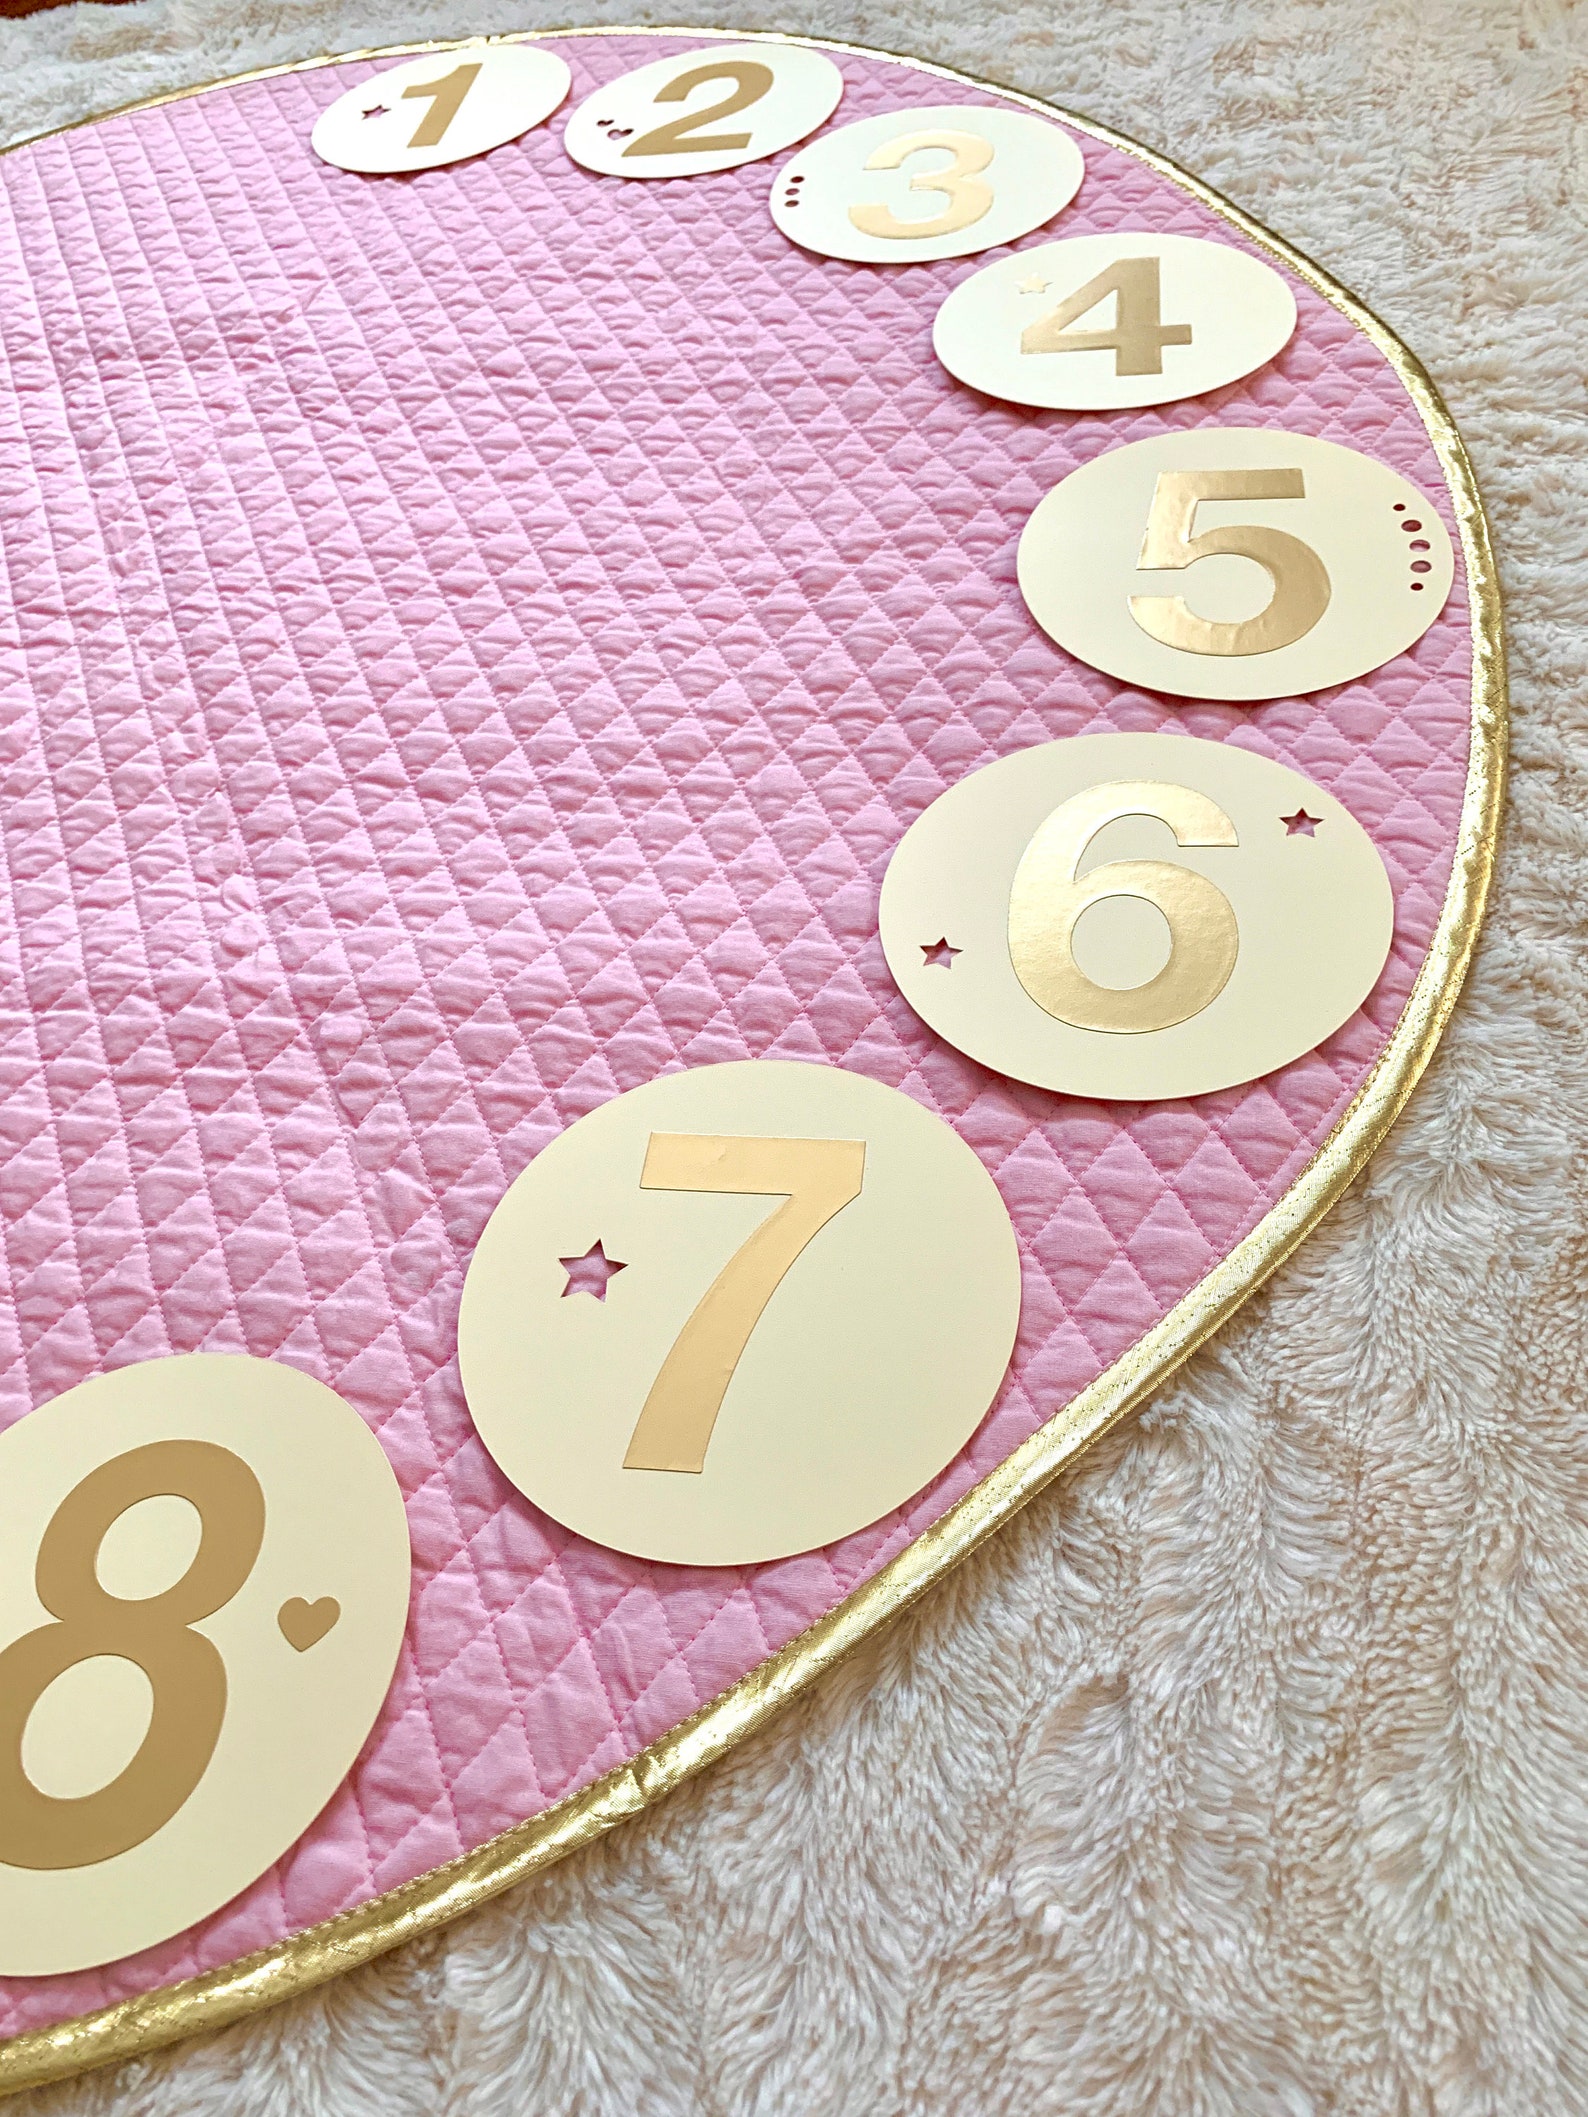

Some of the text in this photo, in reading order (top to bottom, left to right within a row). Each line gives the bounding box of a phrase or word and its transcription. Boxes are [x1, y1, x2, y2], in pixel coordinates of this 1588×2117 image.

[401, 63, 484, 149] 1
[622, 61, 775, 158] 2
[847, 128, 994, 240] 3
[1020, 256, 1193, 377] 4
[1127, 467, 1332, 657] 5
[1007, 779, 1240, 1035] 6
[622, 1131, 867, 1474] 7
[0, 1438, 267, 1871] 8
